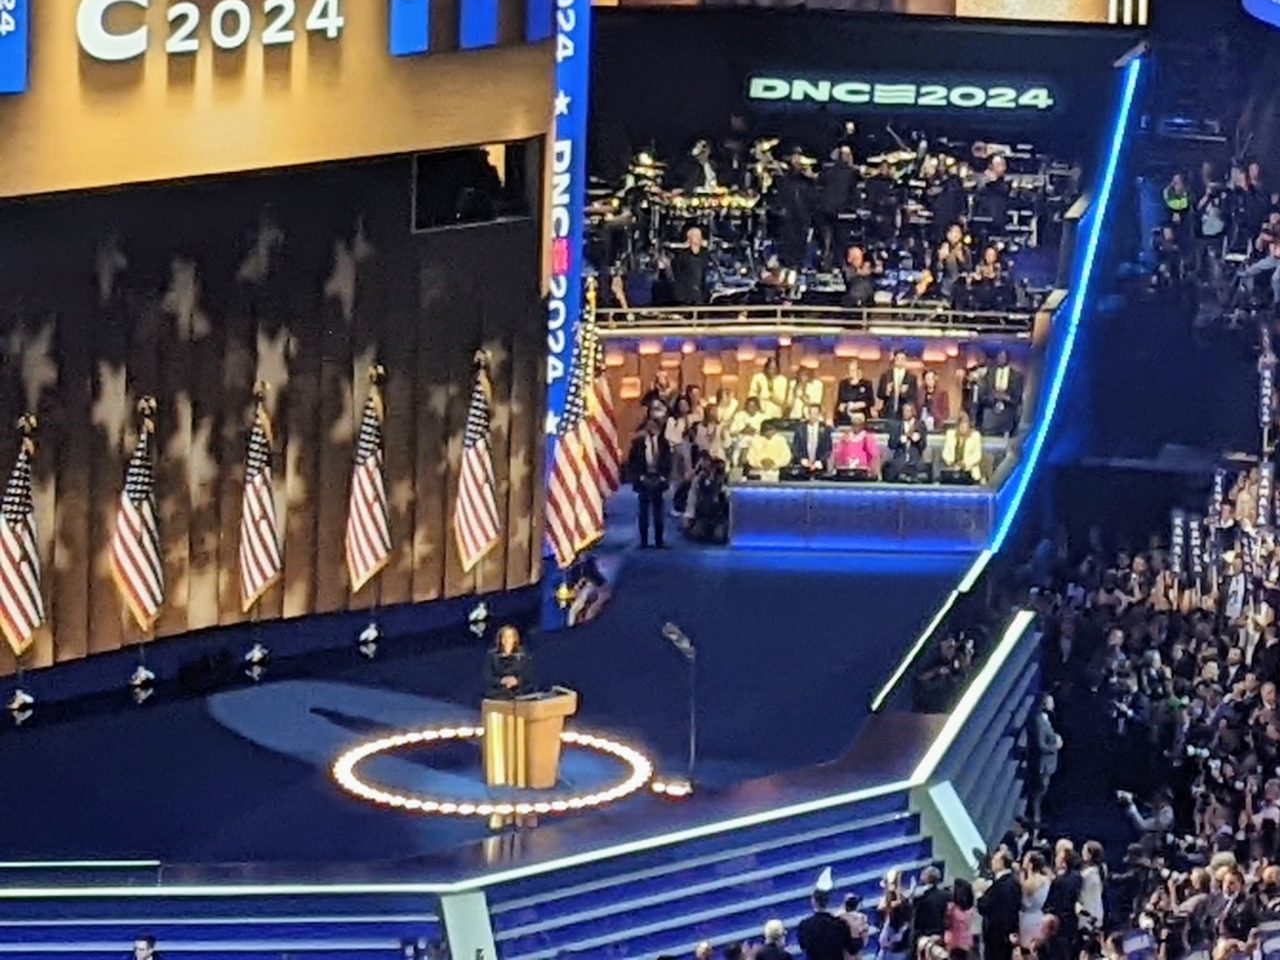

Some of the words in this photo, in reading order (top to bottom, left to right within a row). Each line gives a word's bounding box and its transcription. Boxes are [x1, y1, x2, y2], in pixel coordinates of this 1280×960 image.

[749, 77, 872, 102] DNC
[917, 85, 1054, 109] 2024
[551, 139, 572, 238] DNC
[546, 275, 567, 384] 2024
